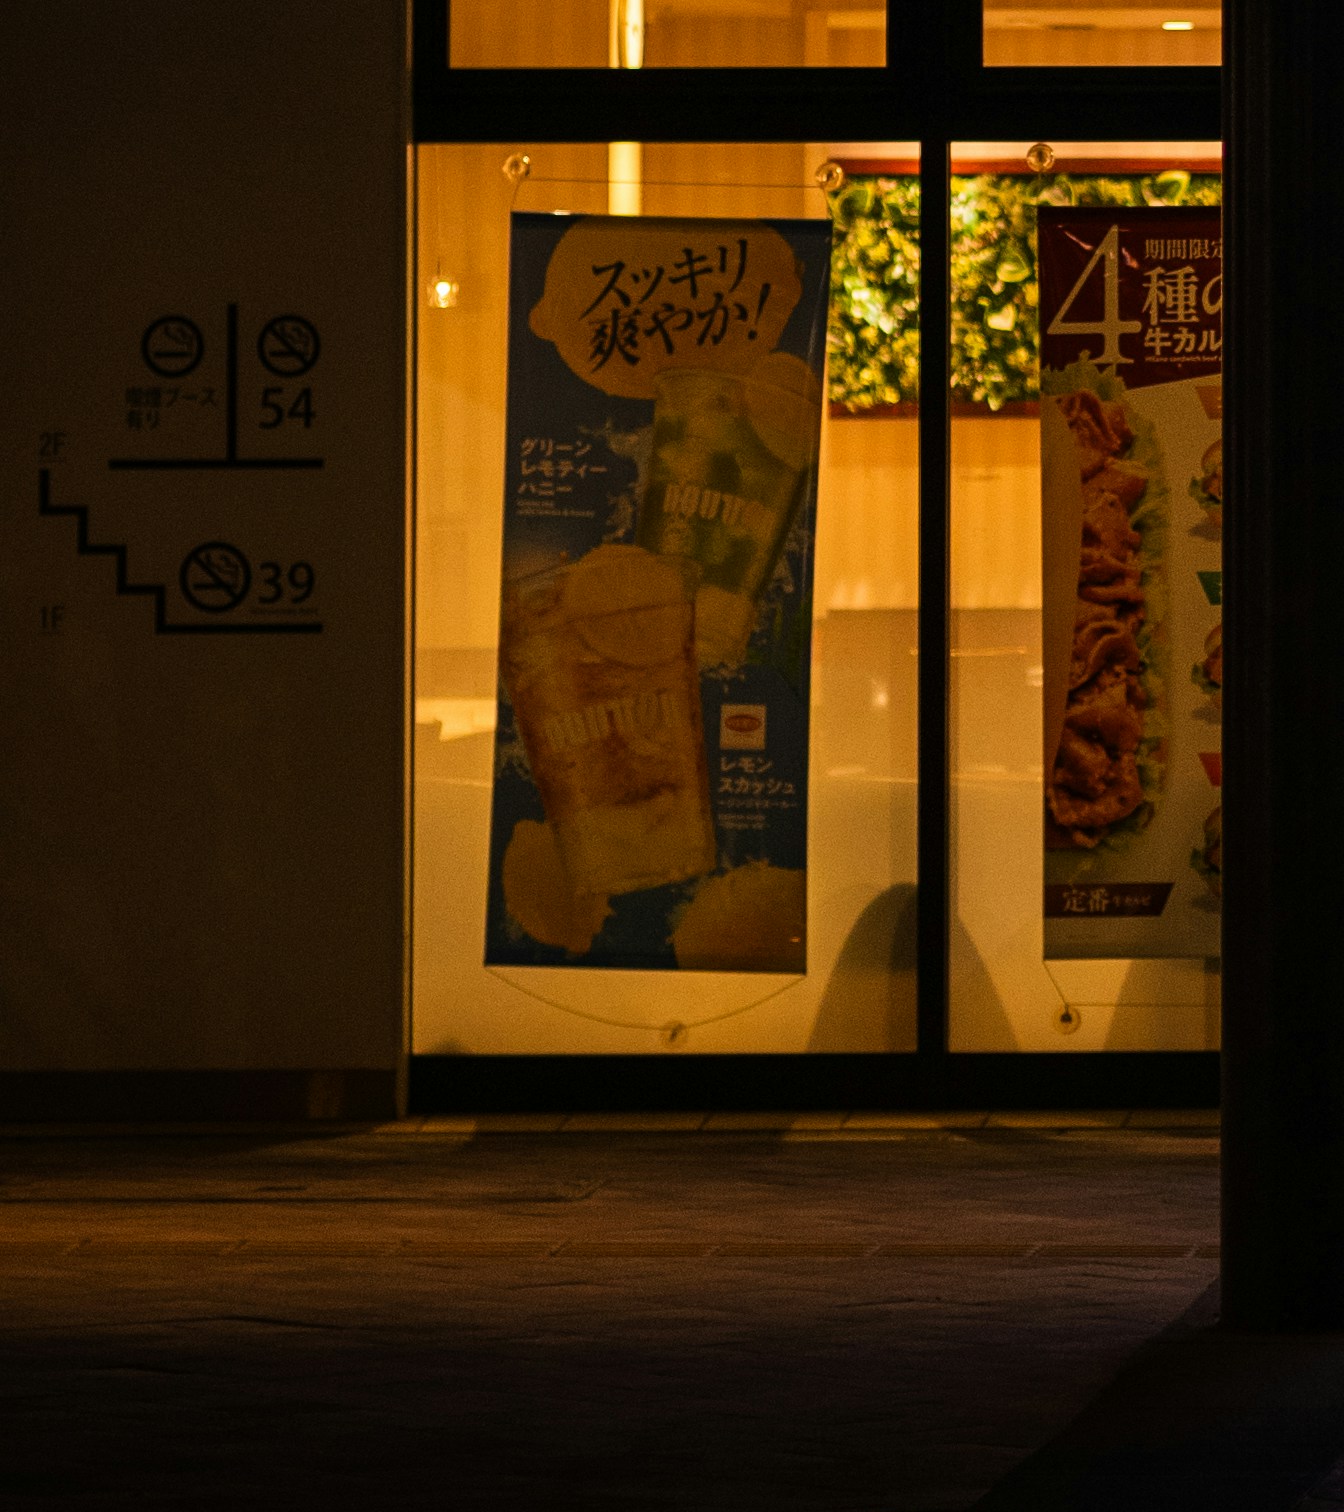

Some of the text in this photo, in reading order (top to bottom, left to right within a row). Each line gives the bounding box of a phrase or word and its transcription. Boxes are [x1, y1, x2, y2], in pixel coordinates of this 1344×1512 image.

[578, 239, 747, 321] スッキリ
[259, 387, 315, 429] 54
[39, 432, 66, 457] 2F
[520, 438, 593, 457] グリーン
[517, 482, 574, 496] ハニー
[258, 562, 314, 604] 39
[721, 757, 774, 773] レモン
[718, 777, 796, 794] スカッシュ
[1061, 887, 1110, 913] 定番
